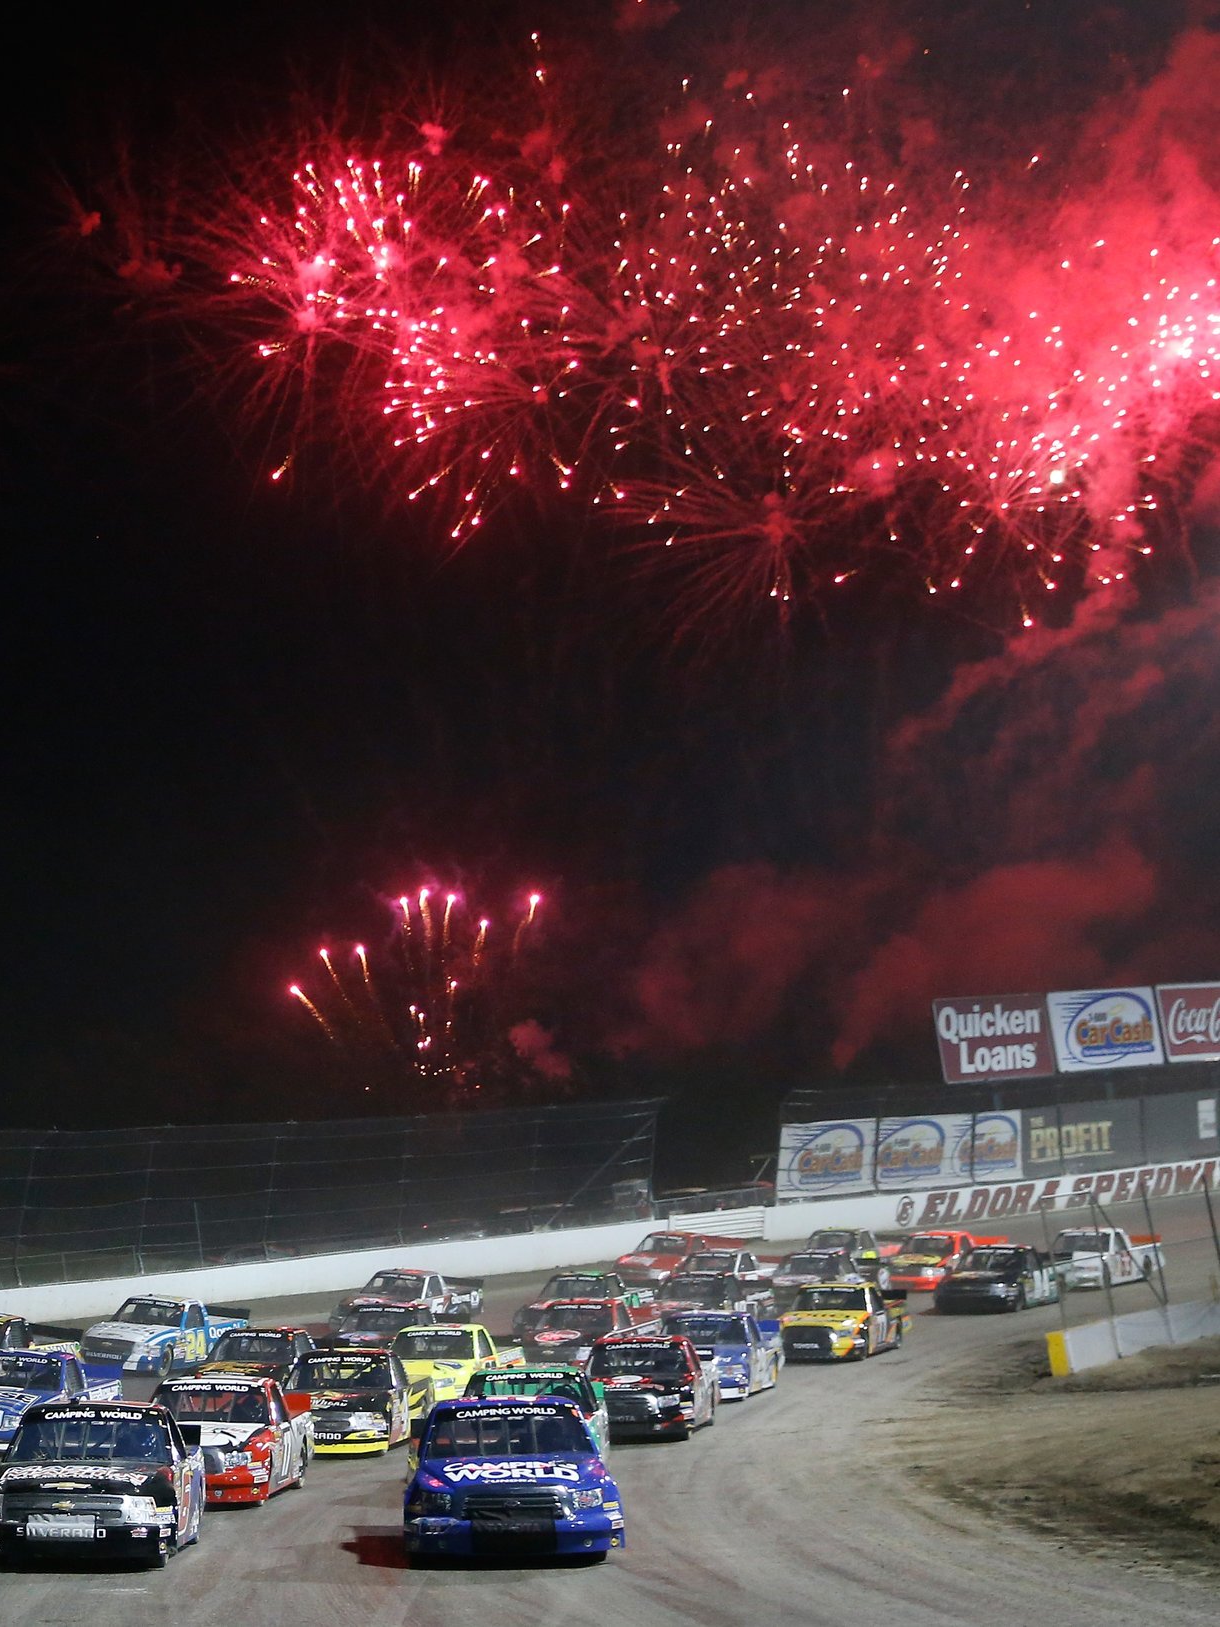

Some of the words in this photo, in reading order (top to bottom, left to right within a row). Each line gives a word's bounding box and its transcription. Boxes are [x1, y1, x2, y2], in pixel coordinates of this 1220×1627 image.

[938, 1004, 1040, 1044] Quicken
[959, 1040, 1037, 1073] Loans
[1030, 1121, 1113, 1160] PROFIT
[919, 1181, 1061, 1225] ELDORA
[1066, 1160, 1220, 1208] SPEEDWA
[184, 1329, 208, 1363] 24
[307, 1356, 341, 1364] CAMPING
[486, 1373, 527, 1382] CAMPING
[171, 1384, 212, 1392] CAMPING
[215, 1384, 249, 1392] WORLD
[45, 1410, 96, 1420] CAMPING
[100, 1410, 144, 1420] WORLD
[456, 1408, 511, 1419] CAMPING
[511, 1407, 557, 1416] WORLD
[444, 1467, 580, 1482] WORLD
[16, 1527, 107, 1539] SILVERADO
